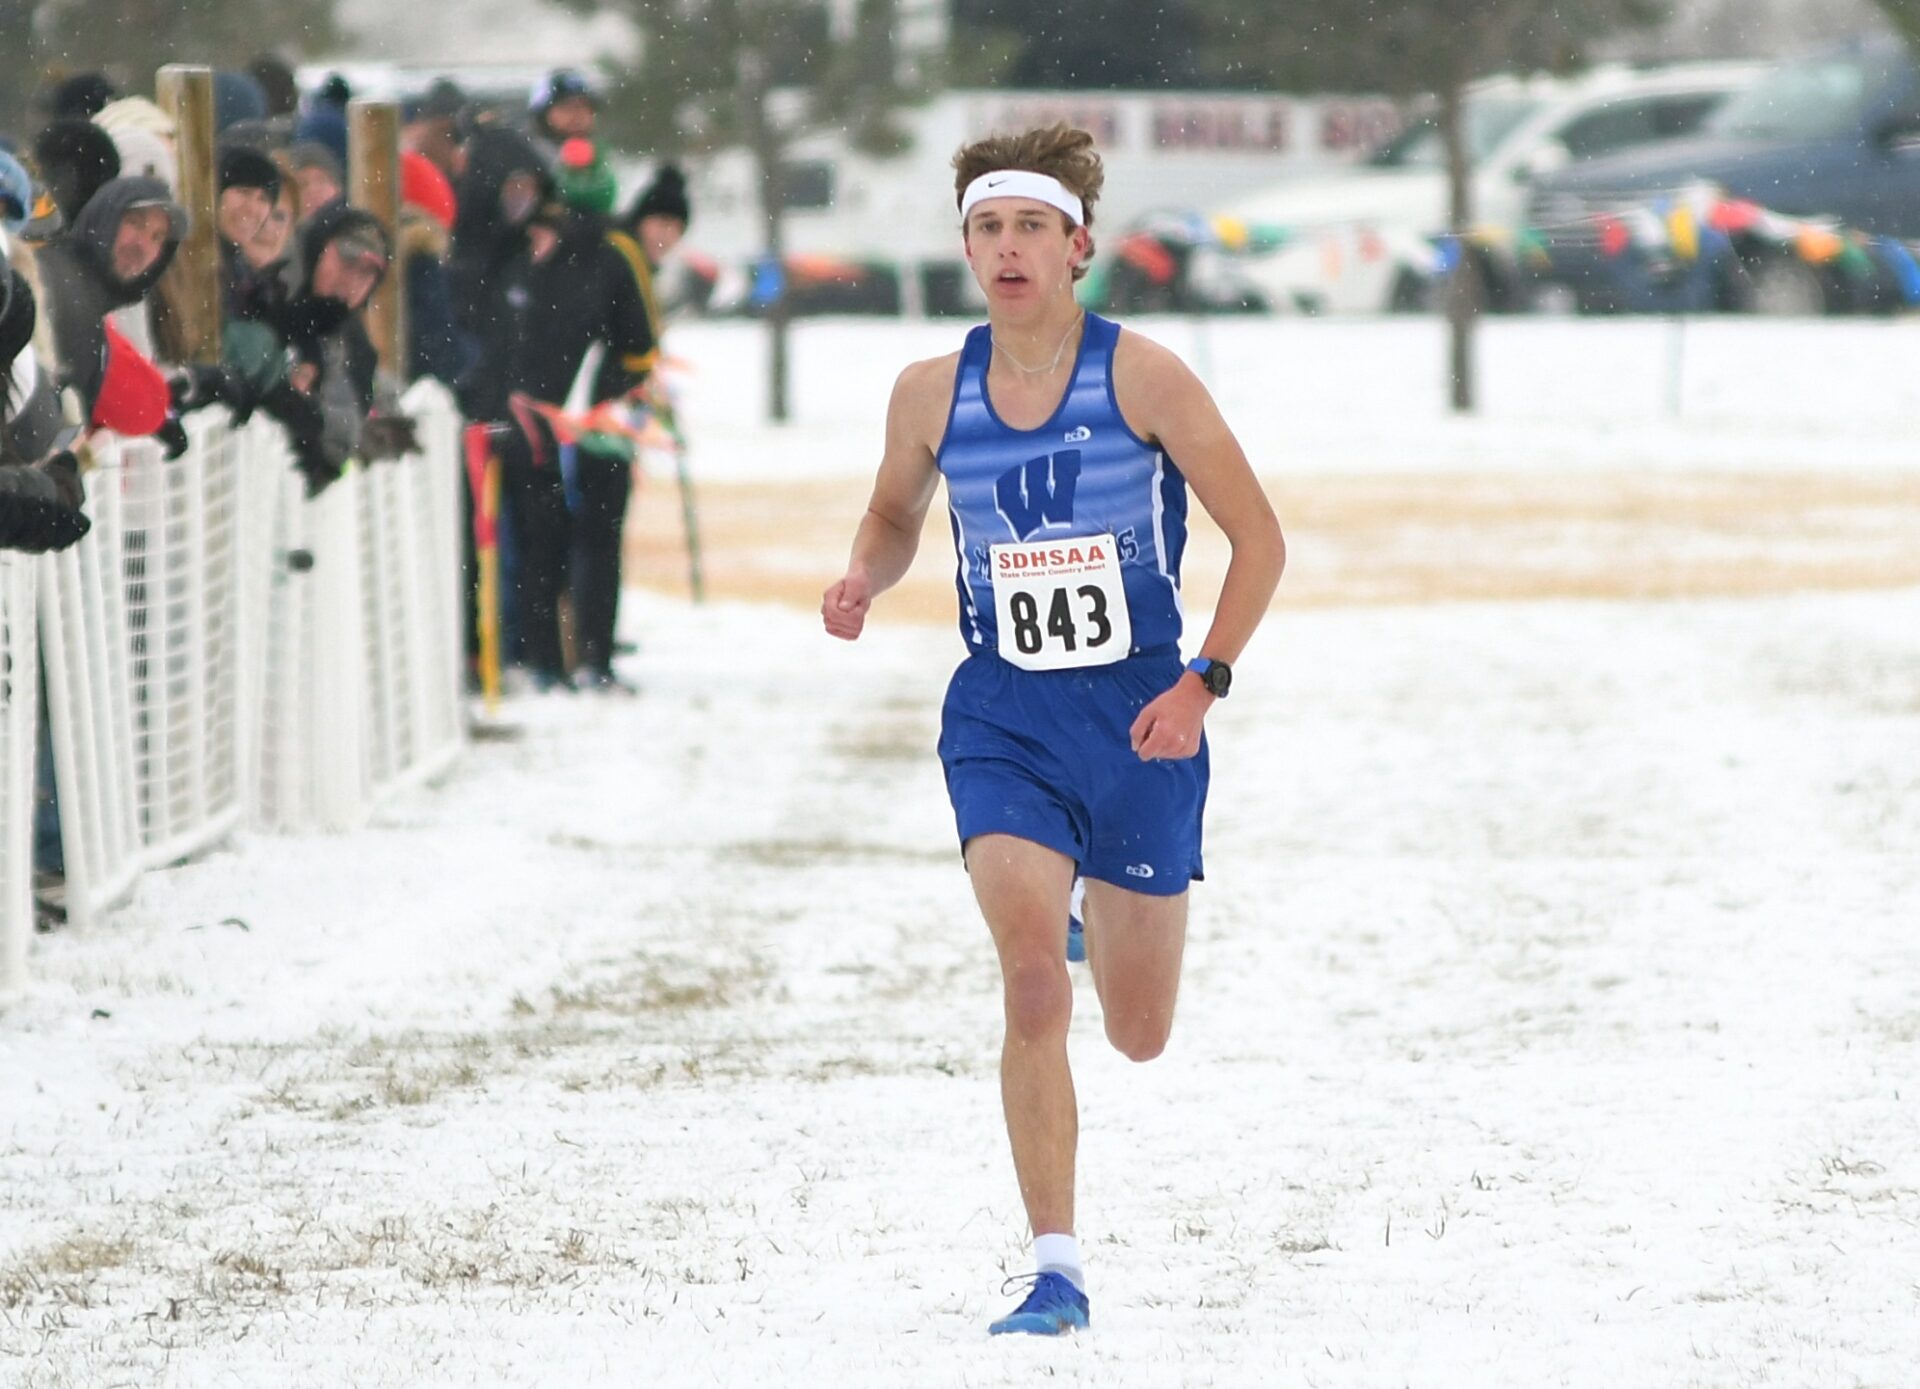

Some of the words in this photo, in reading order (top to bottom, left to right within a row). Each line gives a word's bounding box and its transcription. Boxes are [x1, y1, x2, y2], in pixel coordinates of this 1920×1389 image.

[994, 449, 1082, 543] W
[998, 545, 1106, 570] SDHSAA
[1048, 567, 1082, 575] Country
[1011, 585, 1112, 654] 843
